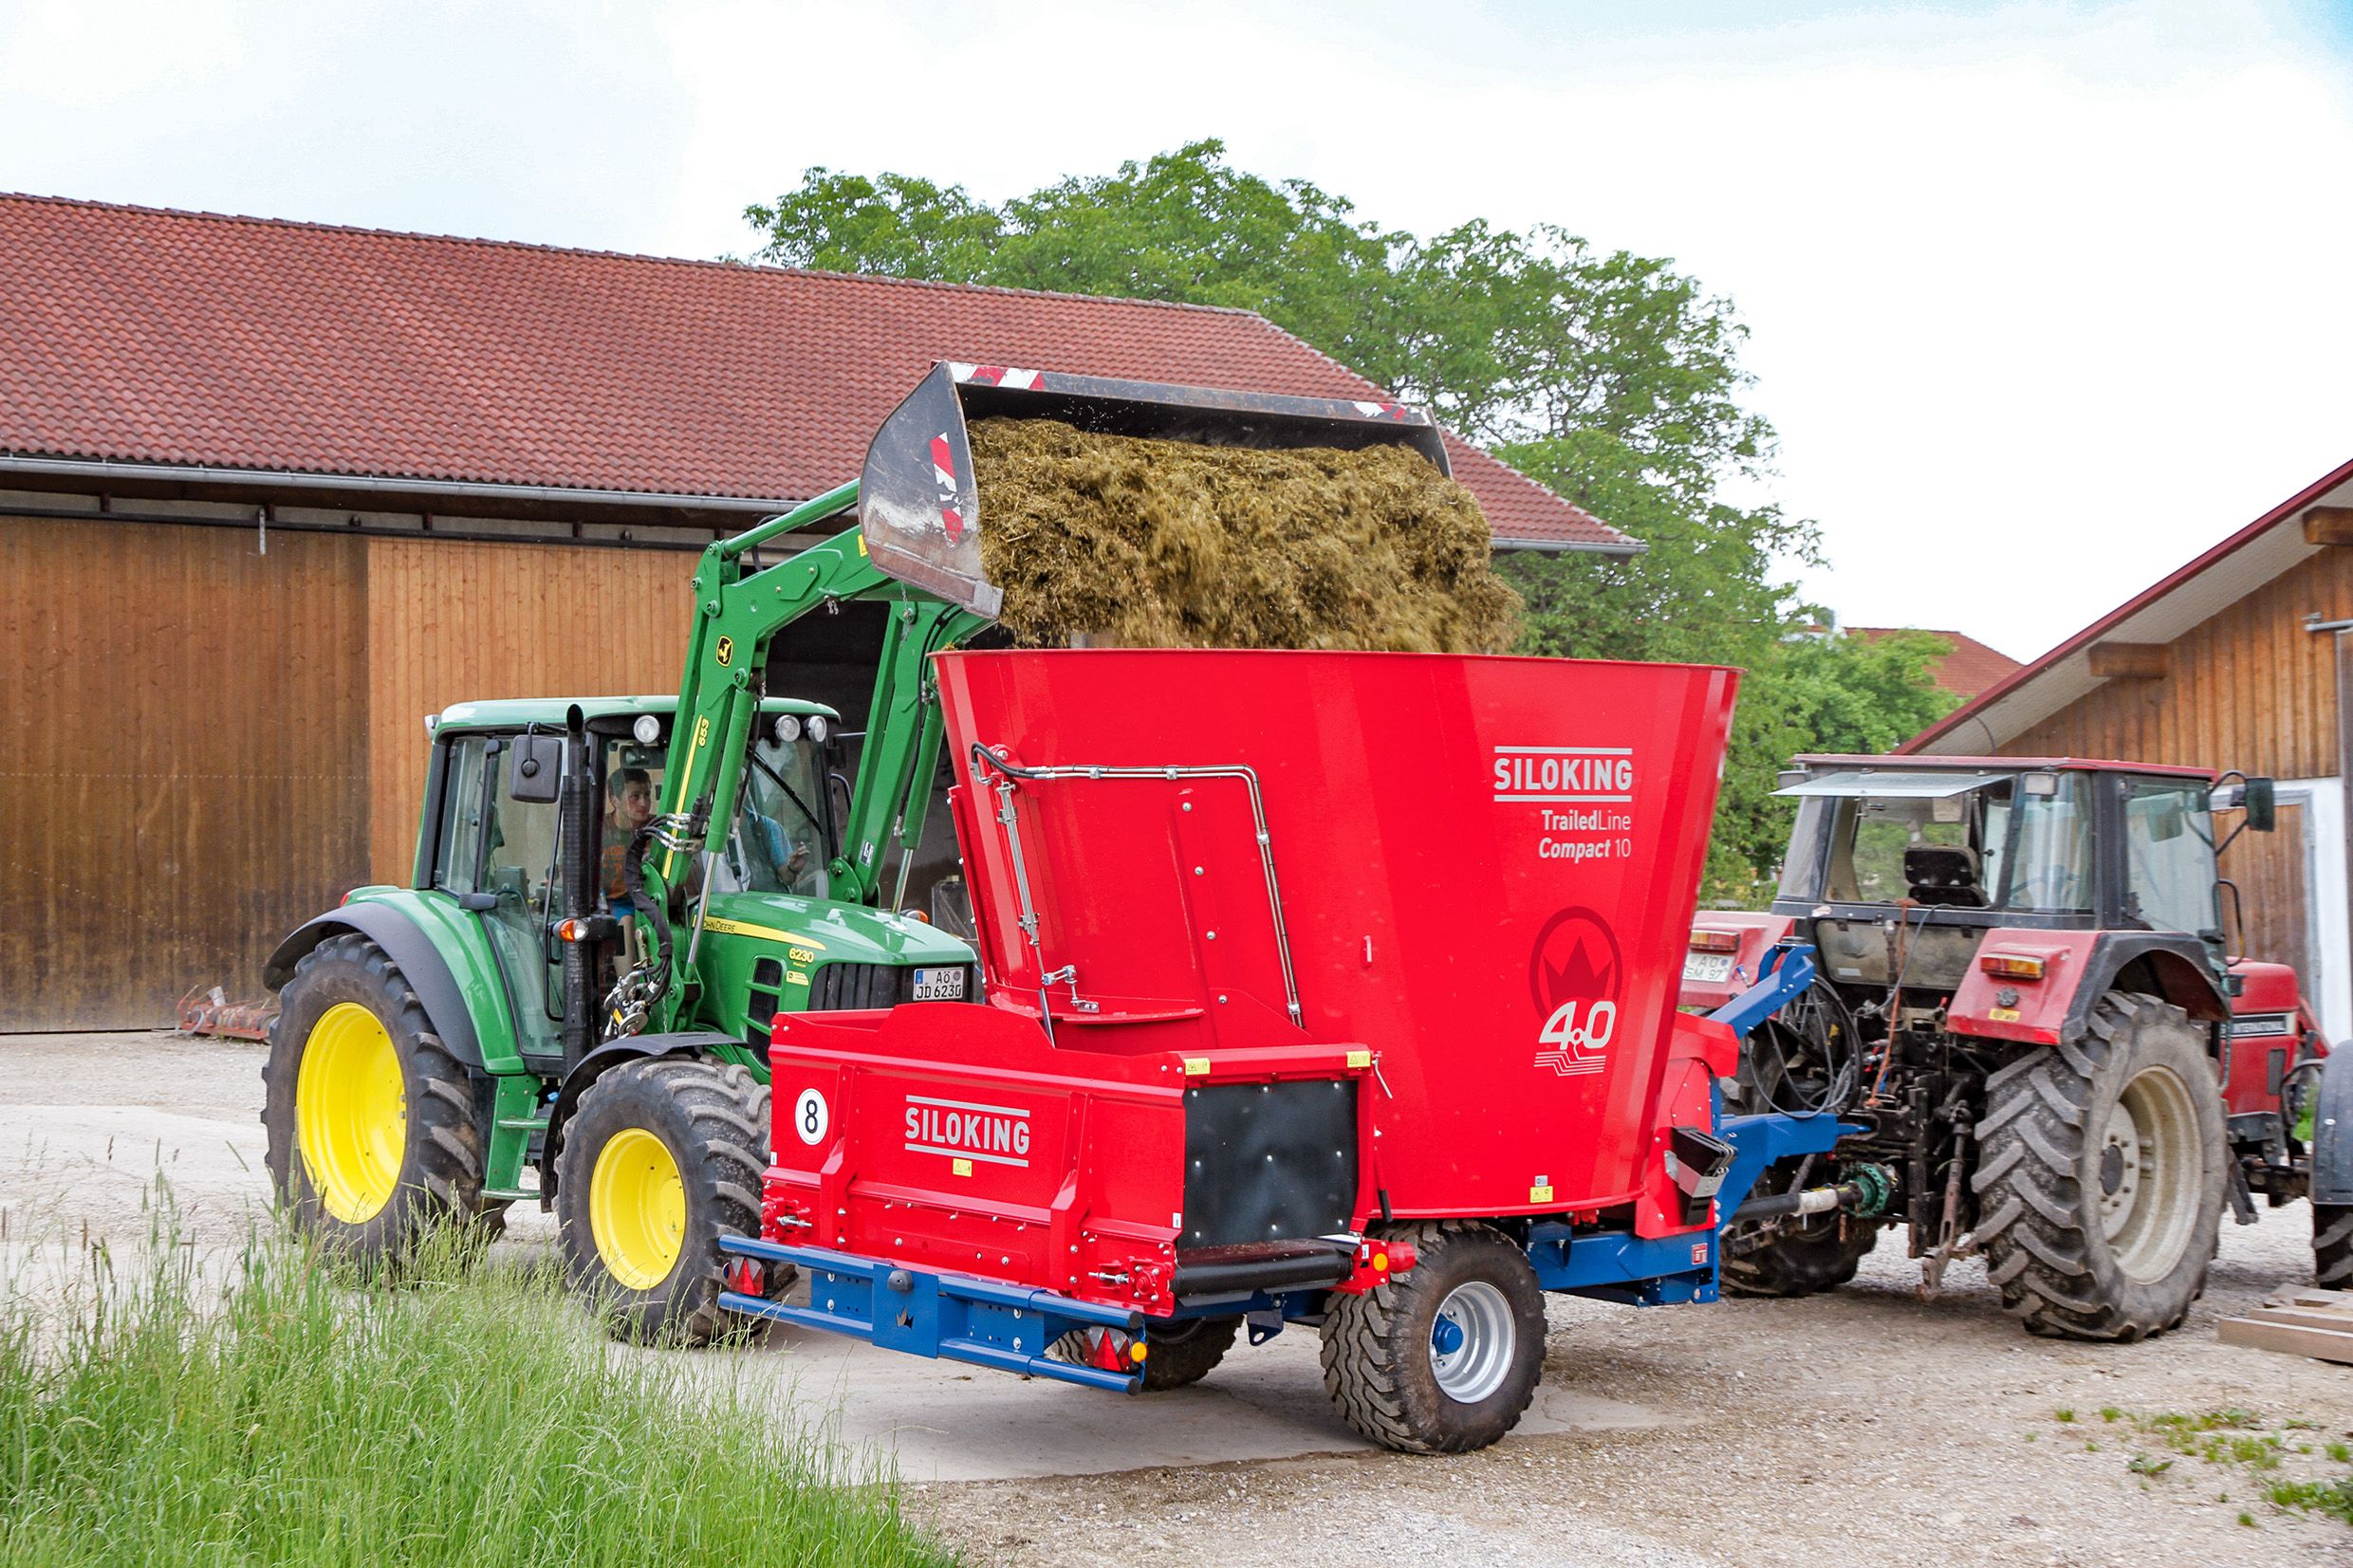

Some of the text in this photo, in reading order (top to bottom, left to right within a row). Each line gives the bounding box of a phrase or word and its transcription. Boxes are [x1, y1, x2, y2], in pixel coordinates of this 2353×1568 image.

[698, 718, 710, 747] 653
[1494, 758, 1633, 790] SILOKING
[1541, 809, 1632, 830] TrailedLine
[1539, 837, 1631, 864] Compact 10
[715, 920, 736, 932] DEERE
[788, 948, 814, 963] 6230
[936, 970, 951, 984] AÖ
[917, 984, 961, 999] JD 6230
[805, 1099, 818, 1134] 8
[905, 1107, 1030, 1154] SILOKING
